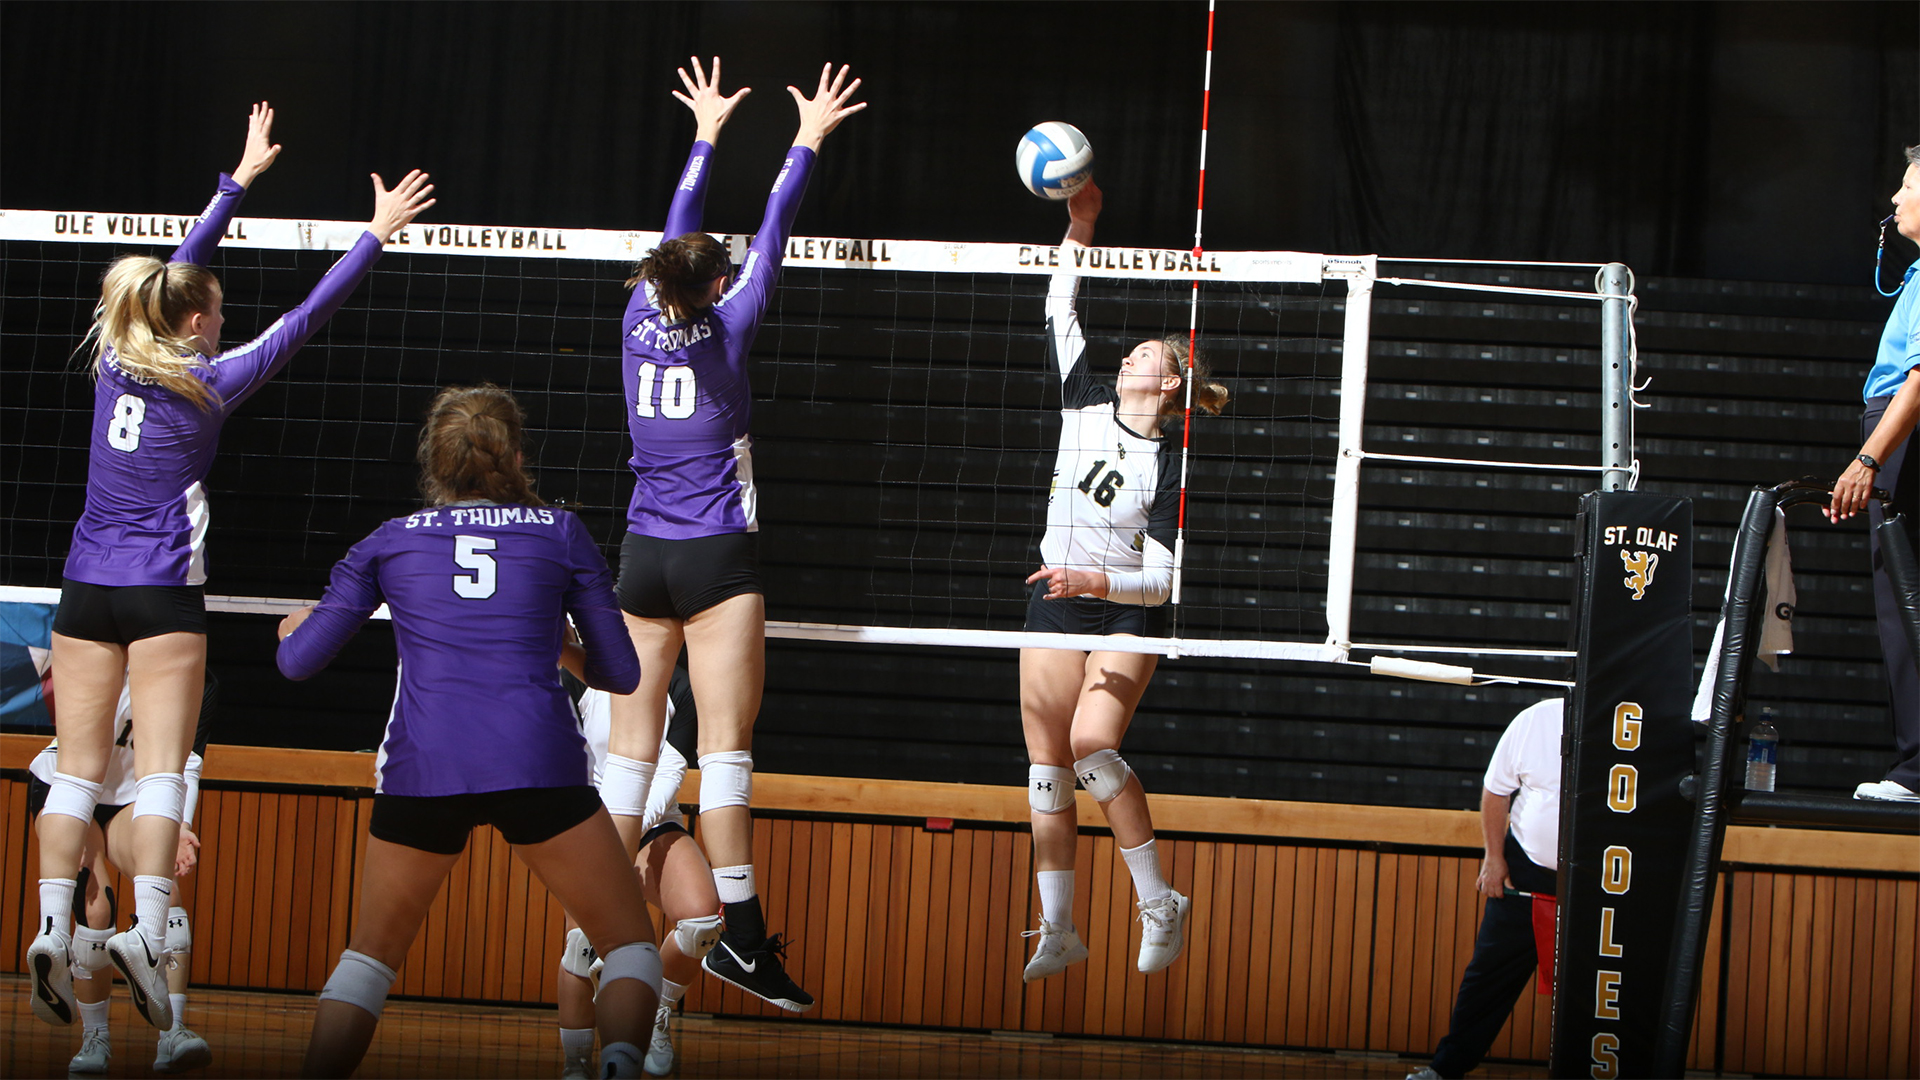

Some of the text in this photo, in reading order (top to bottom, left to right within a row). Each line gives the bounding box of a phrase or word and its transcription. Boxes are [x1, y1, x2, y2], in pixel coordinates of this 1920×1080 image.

[55, 213, 94, 235] OLE
[423, 226, 567, 251] VOLLEYBALL
[1018, 246, 1222, 273] OLE VOLLEYBALL
[631, 318, 656, 346] ST.
[636, 361, 697, 420] 10
[107, 393, 146, 454] 8
[1077, 459, 1125, 508] 16
[405, 511, 442, 529] ST.
[1603, 525, 1679, 552] ST. OLAF
[453, 534, 498, 600] 5
[1607, 701, 1643, 814] GO
[1590, 845, 1633, 1080] OLES
